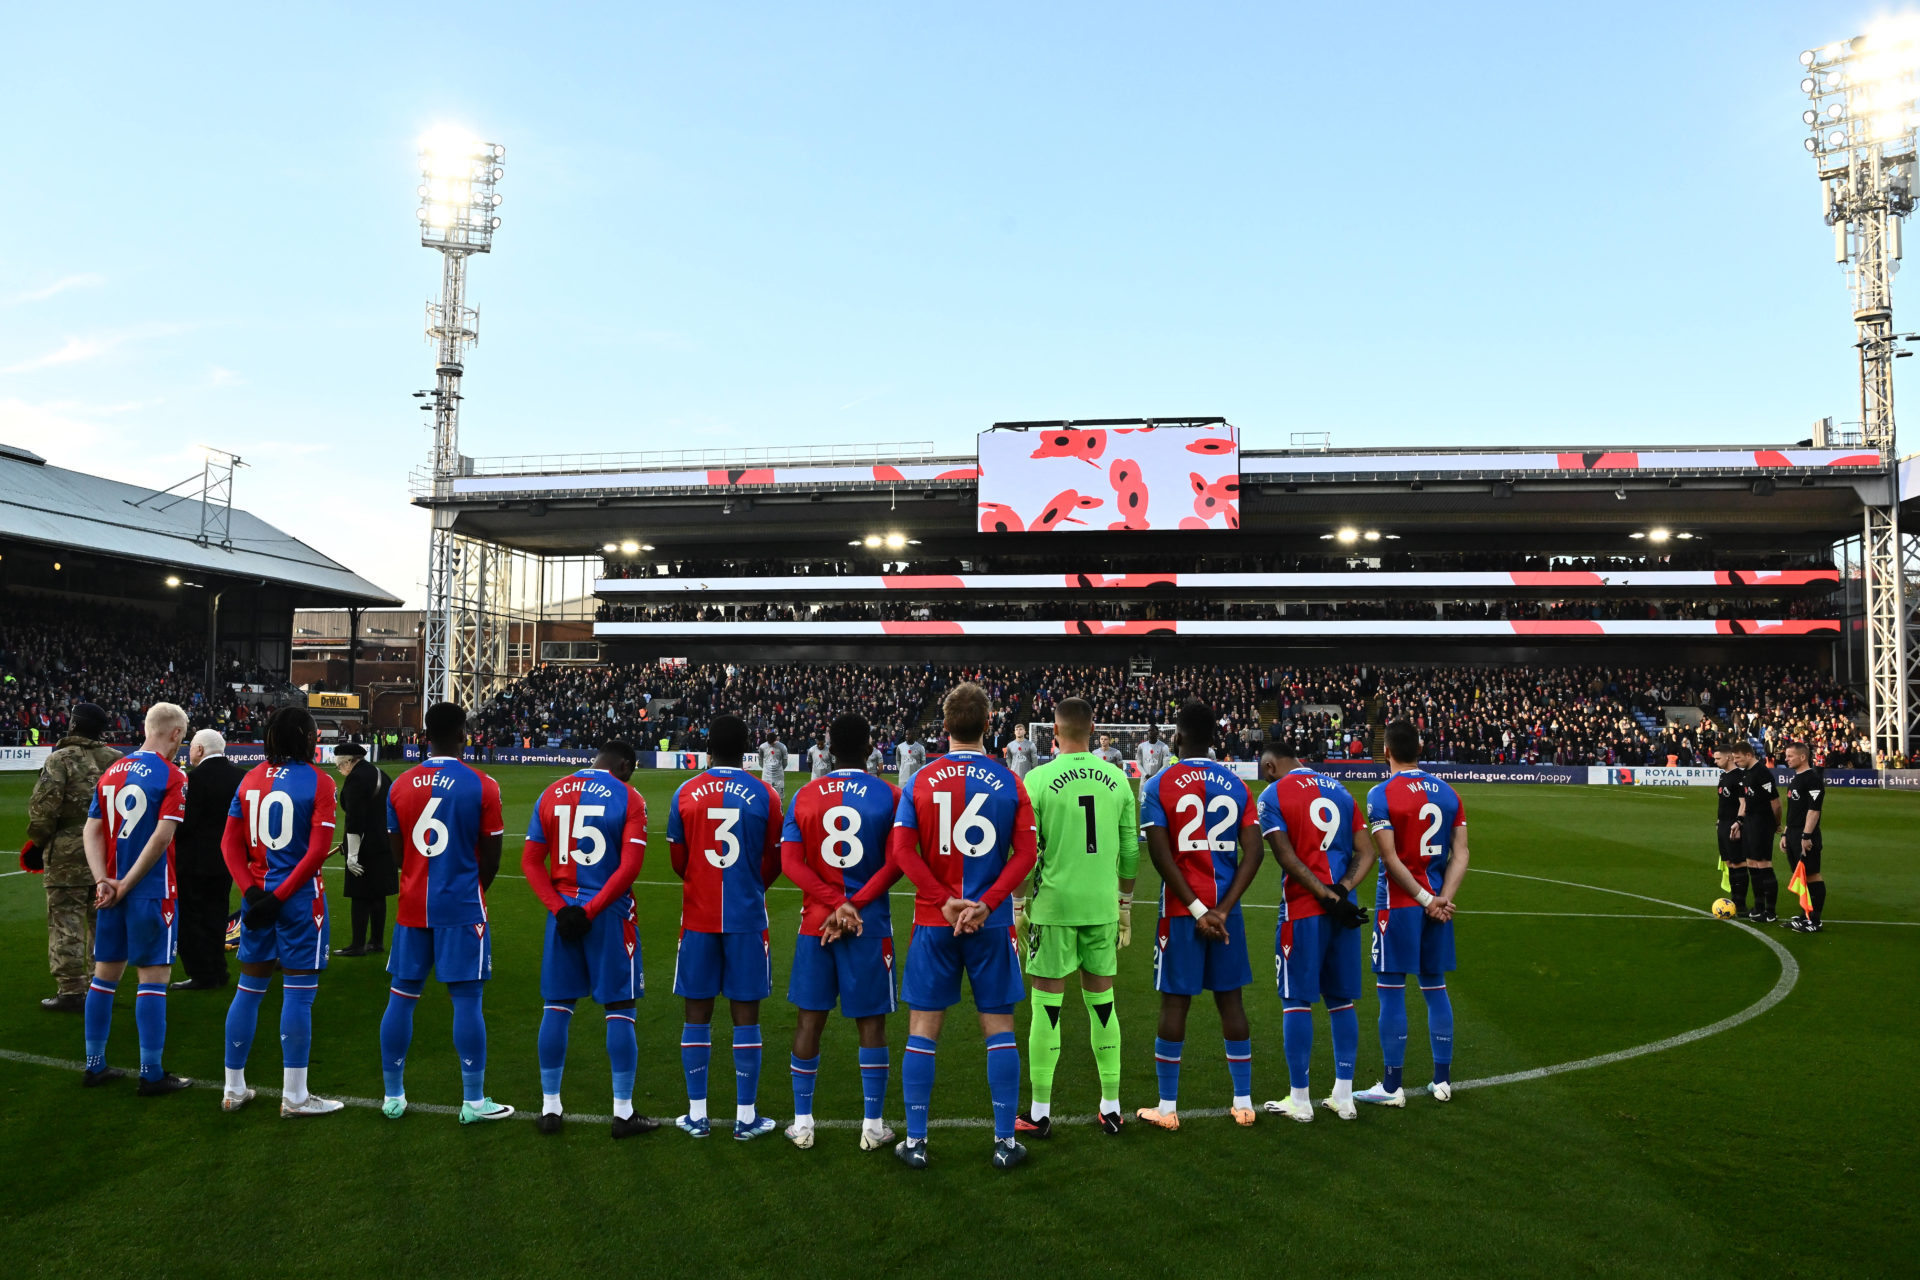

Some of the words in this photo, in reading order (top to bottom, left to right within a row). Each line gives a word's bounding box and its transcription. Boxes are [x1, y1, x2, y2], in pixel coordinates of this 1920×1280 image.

[109, 761, 152, 778] HUGHES
[521, 754, 596, 765] premierleague.c
[265, 767, 290, 779] EZE
[412, 771, 456, 790] GUÉHI
[927, 765, 1004, 791] ANDERSEN
[1048, 768, 1118, 795] JOHNSTONE
[1174, 770, 1233, 791] EDOUARD
[1345, 770, 1377, 779] dream
[1429, 771, 1572, 783] remierleague.com/poppy
[1645, 769, 1682, 777] ROYAL
[1889, 776, 1919, 785] shirt
[554, 781, 612, 799] SCHLUPP
[691, 780, 757, 806] MITCHELL
[818, 781, 868, 798] LERMA
[1406, 781, 1439, 794] WARD
[102, 784, 147, 839] 19
[245, 789, 294, 852] 10
[932, 791, 997, 857] 16
[1078, 795, 1097, 854] 1
[1175, 793, 1238, 852] 22
[1309, 797, 1341, 851] 9
[412, 797, 449, 857] 6
[554, 805, 607, 866] 15
[704, 808, 740, 869] 3
[820, 805, 864, 869] 8
[1418, 803, 1443, 857] 2
